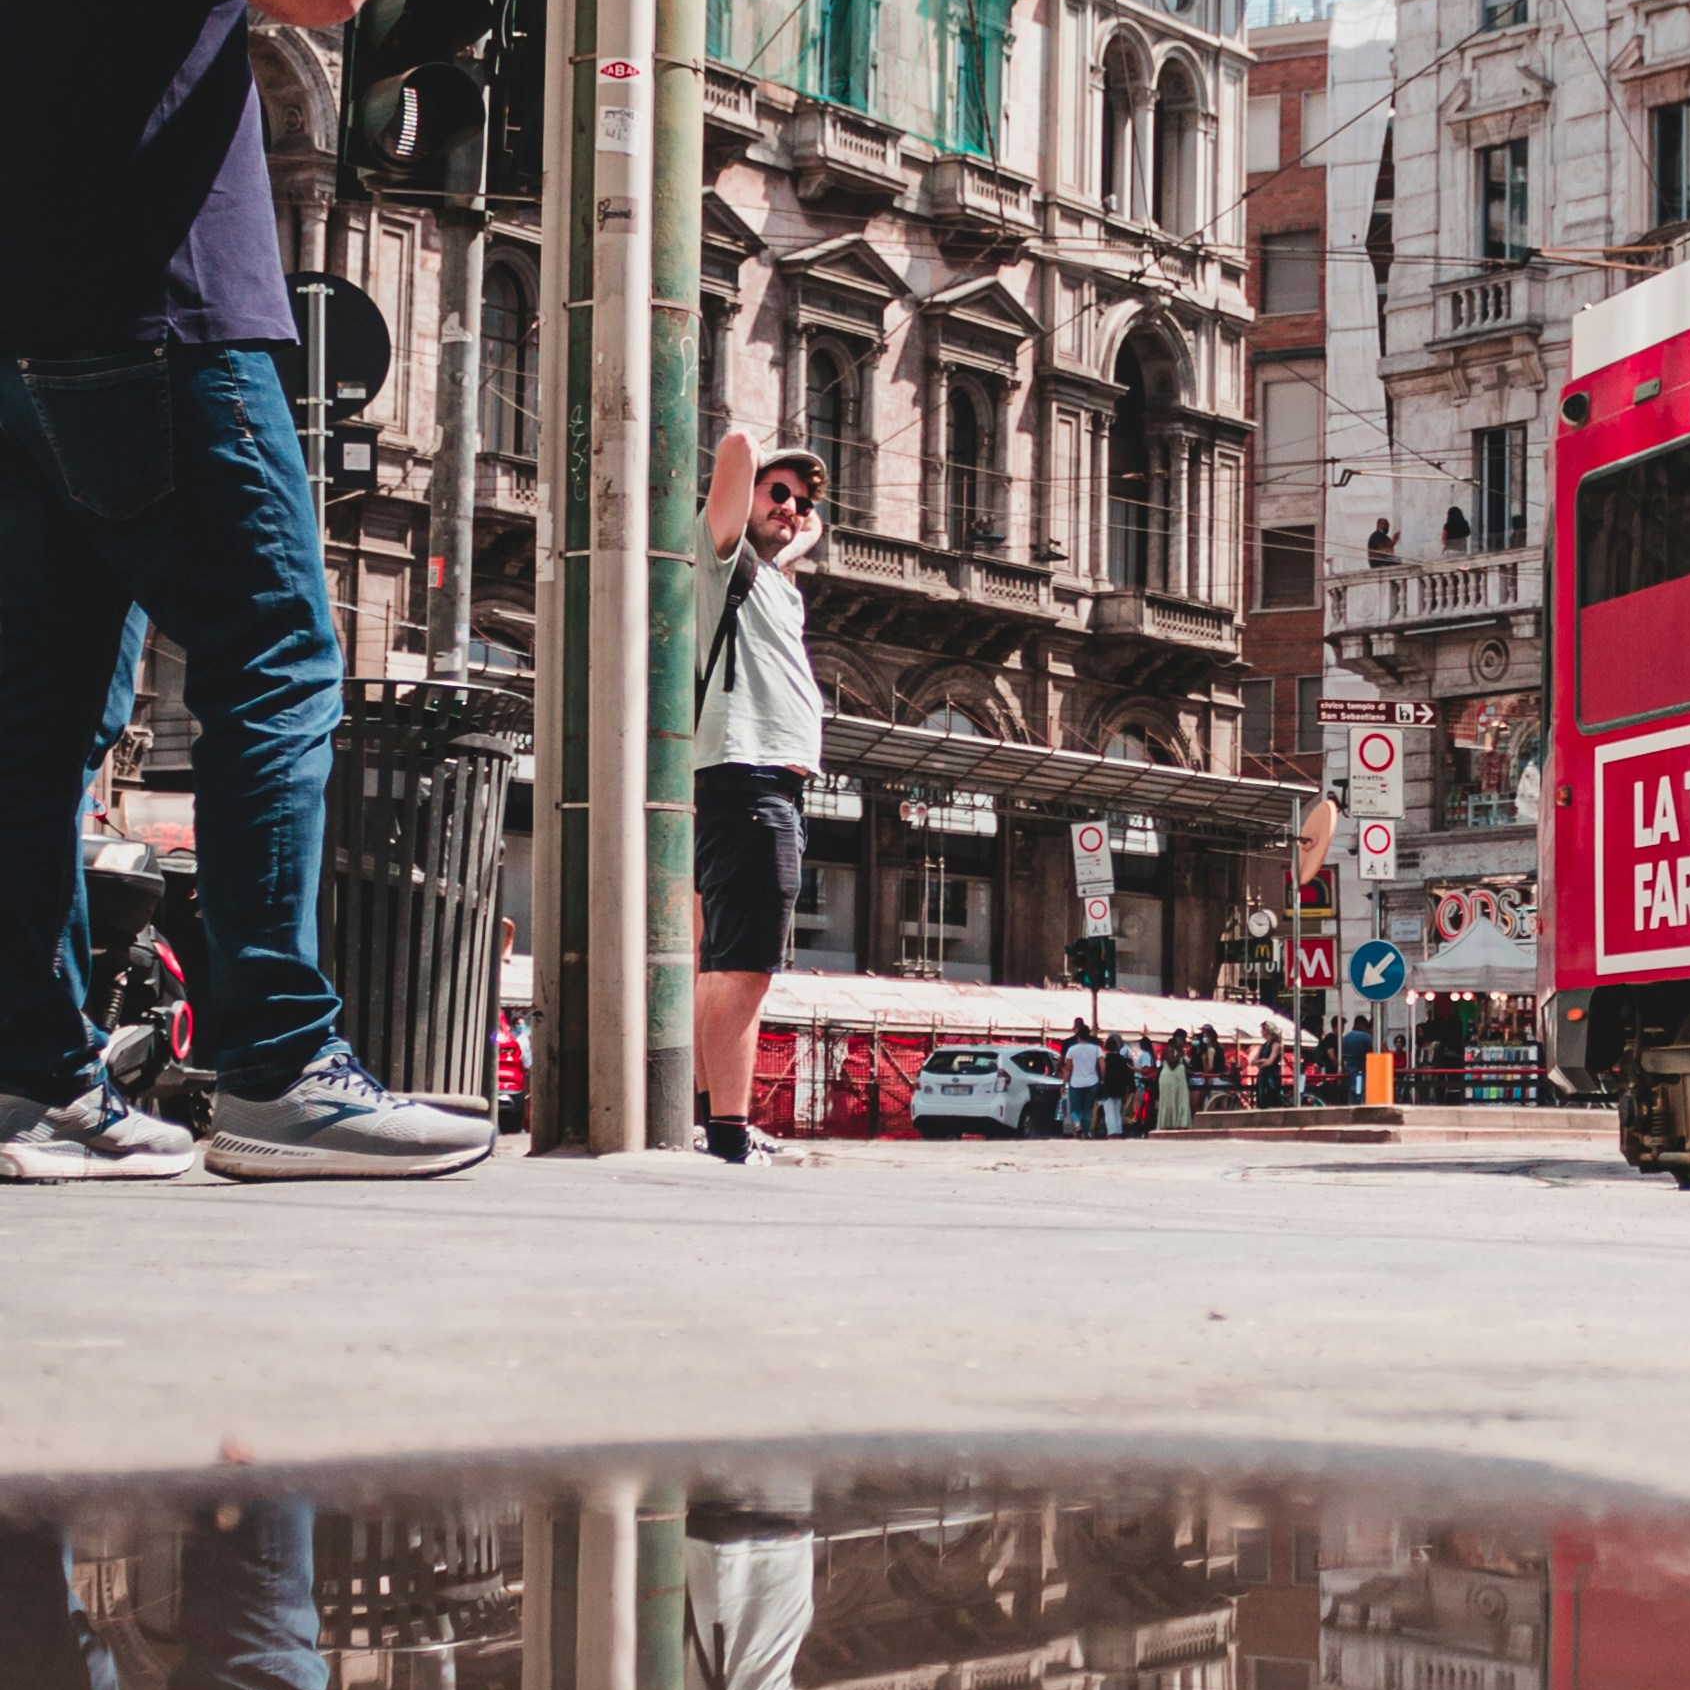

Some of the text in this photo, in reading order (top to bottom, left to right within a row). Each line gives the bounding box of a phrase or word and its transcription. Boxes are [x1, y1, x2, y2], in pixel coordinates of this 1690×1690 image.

[1320, 702, 1386, 711] civico tempio di
[1320, 711, 1386, 721] San Sebastiano
[1635, 776, 1679, 847] LA
[1290, 948, 1331, 978] M
